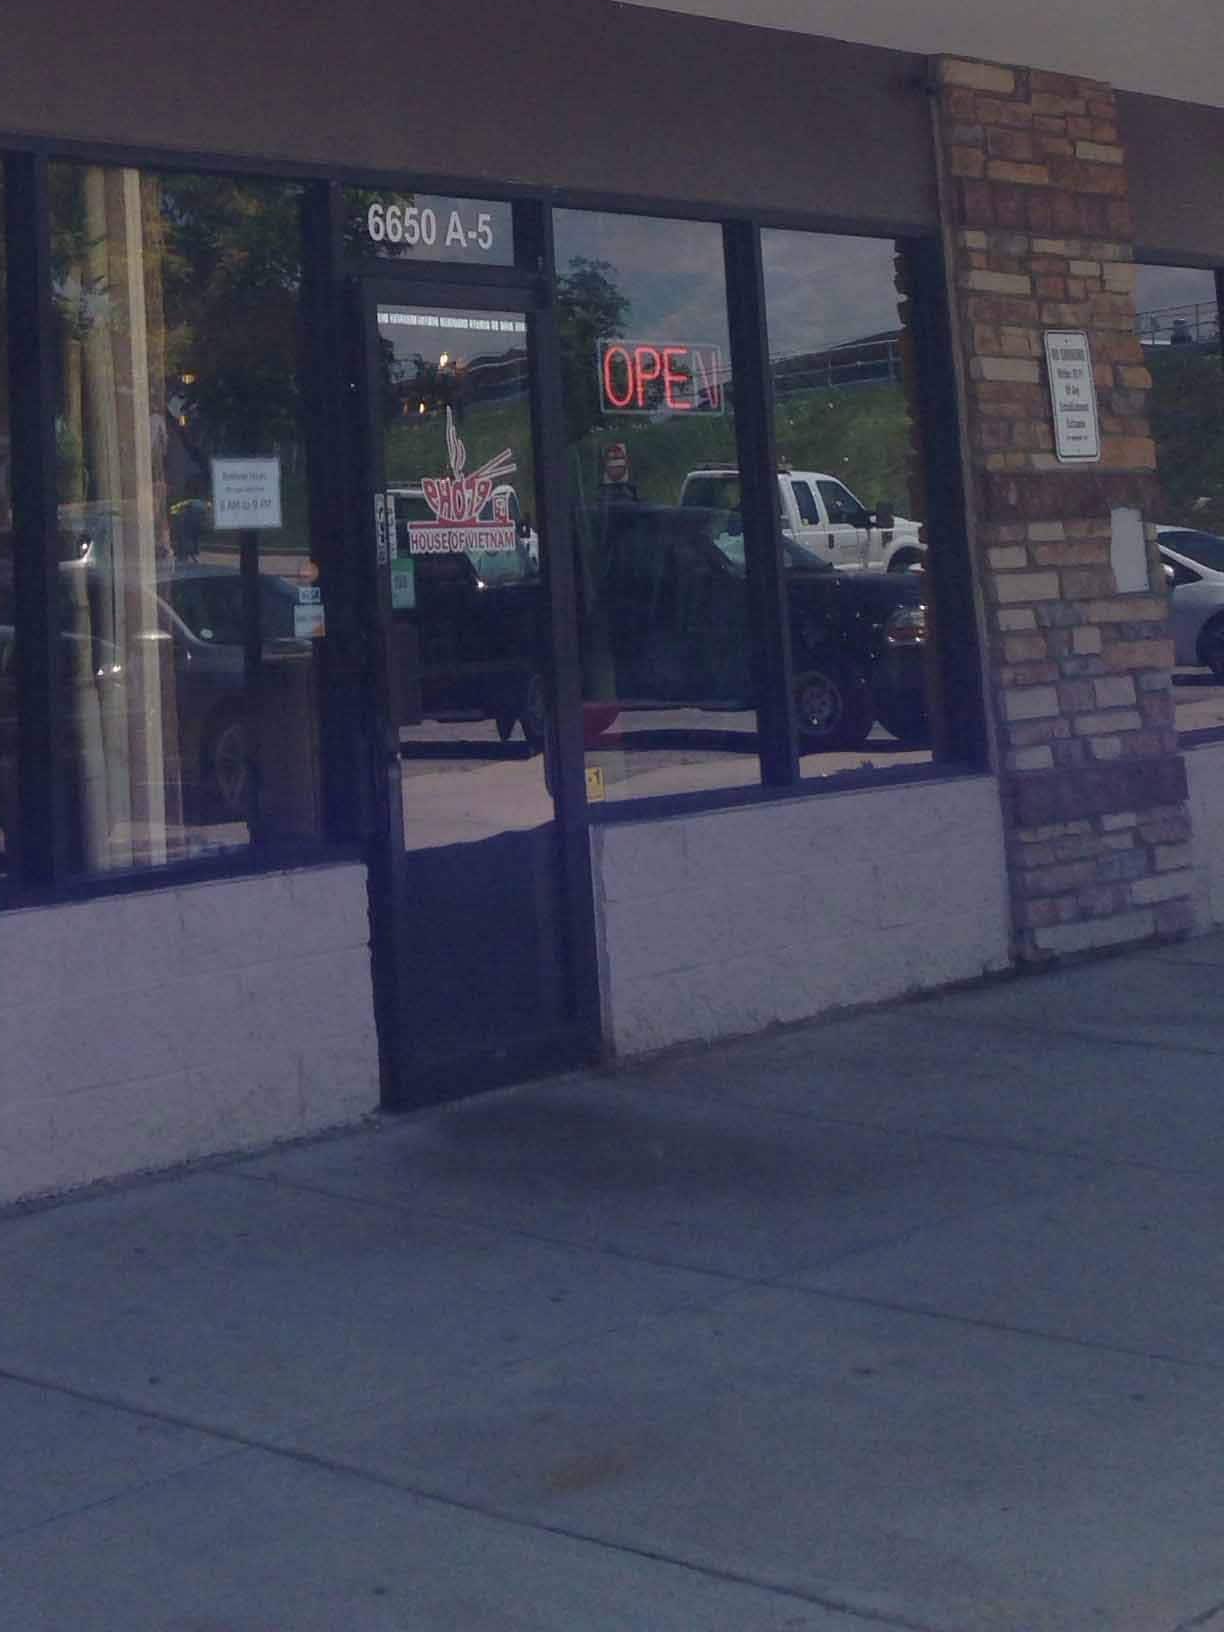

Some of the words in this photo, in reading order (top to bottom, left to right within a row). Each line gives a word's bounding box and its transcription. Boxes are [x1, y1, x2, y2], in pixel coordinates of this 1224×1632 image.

[368, 203, 437, 246] 6650
[445, 211, 494, 250] A-5
[603, 344, 721, 409] OPEN
[411, 531, 449, 550] HOUSE
[450, 531, 465, 549] OF
[466, 530, 515, 548] VIETNAM
